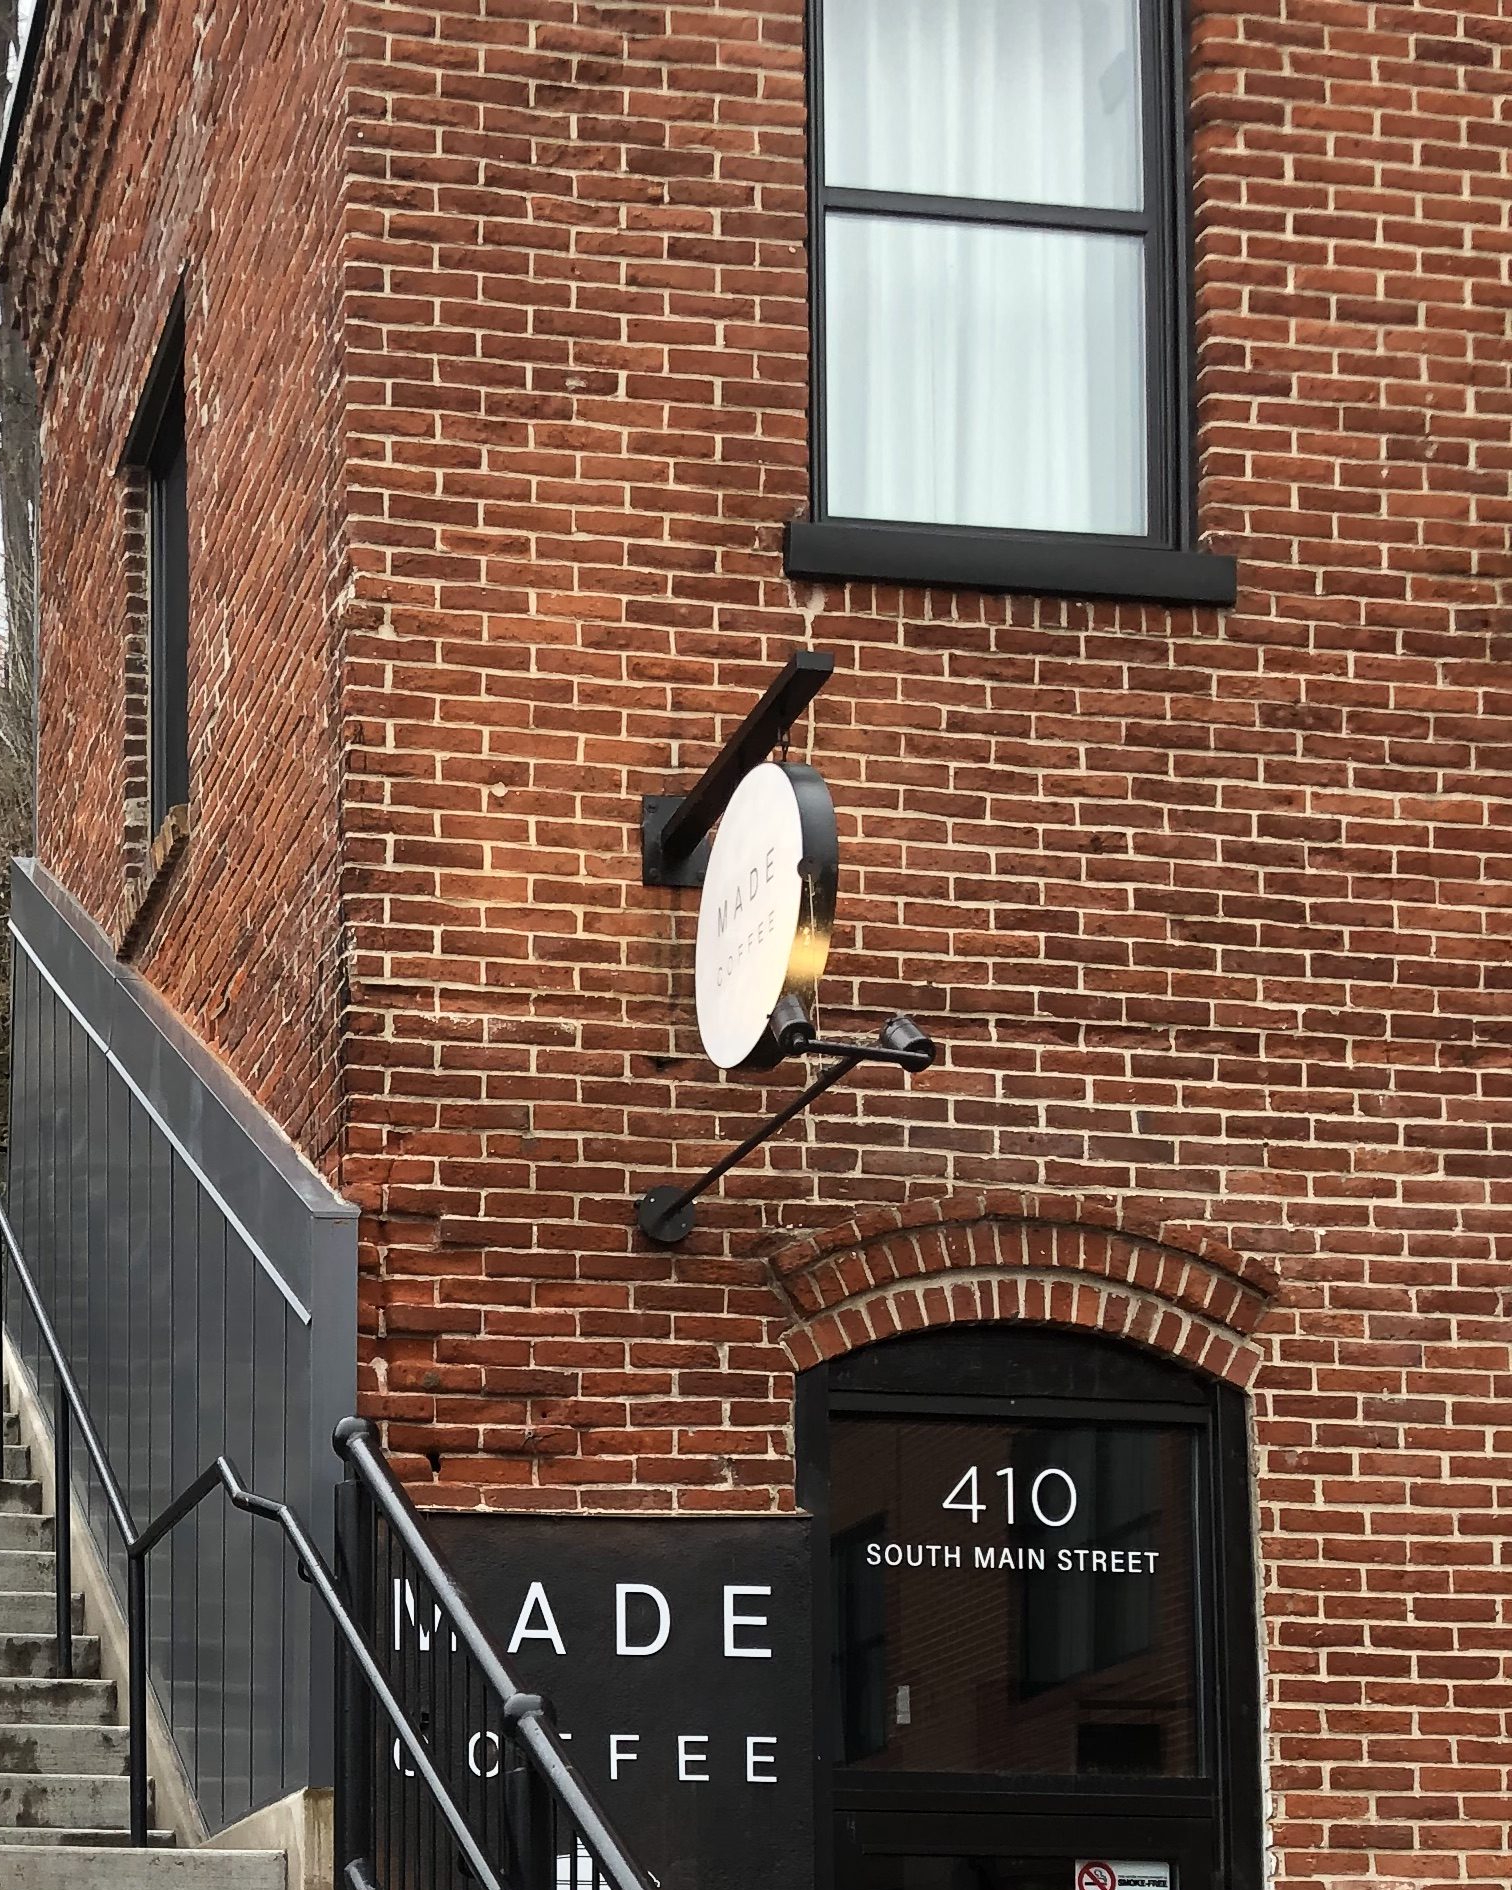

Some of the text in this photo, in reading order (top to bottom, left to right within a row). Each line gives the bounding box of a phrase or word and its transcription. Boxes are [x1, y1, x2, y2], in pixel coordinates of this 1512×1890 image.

[717, 847, 775, 937] MADE
[716, 910, 775, 987] COFFEE
[941, 1465, 1078, 1527] 410
[866, 1543, 1161, 1574] SOUTH MAIN STREET
[392, 1730, 779, 1783] OFEE
[1117, 1878, 1169, 1888] SMOKE-FREE
